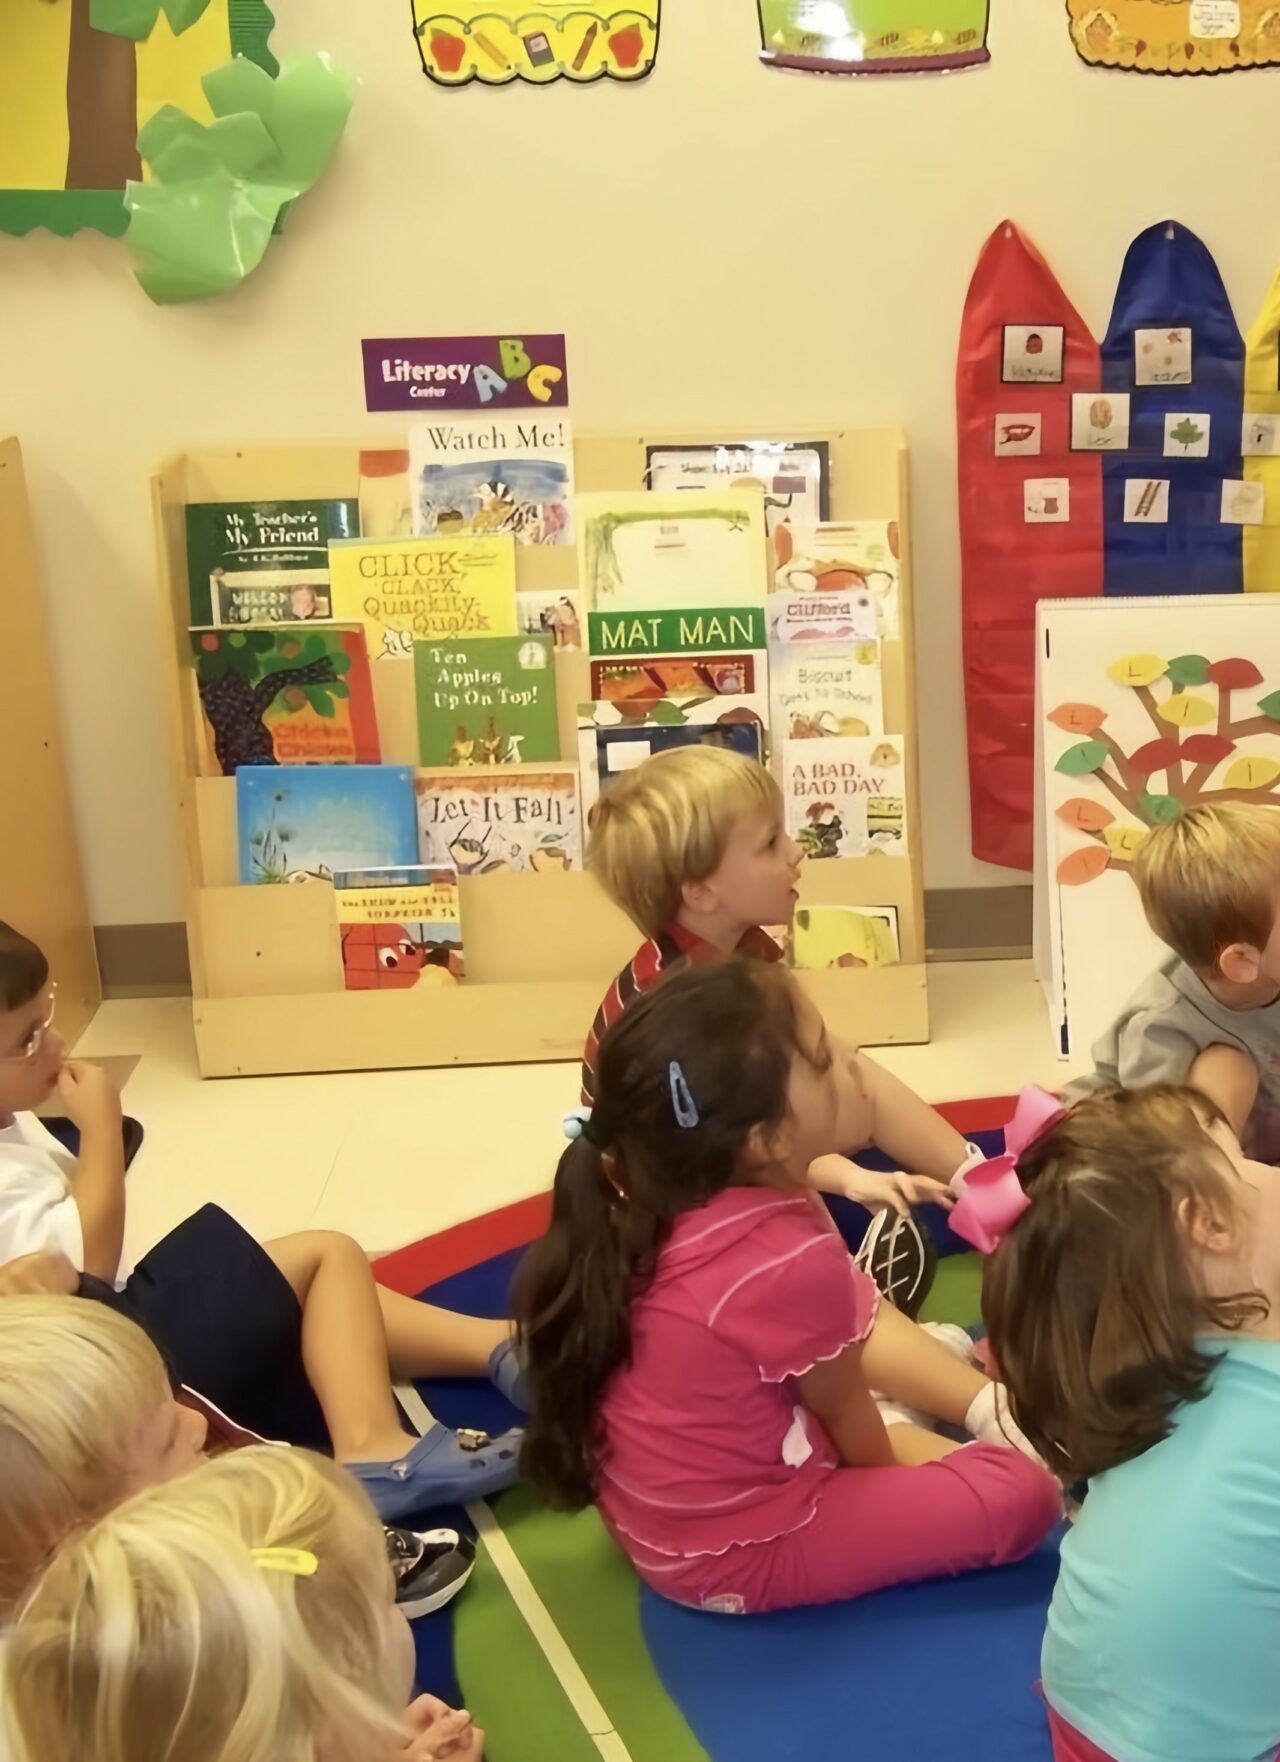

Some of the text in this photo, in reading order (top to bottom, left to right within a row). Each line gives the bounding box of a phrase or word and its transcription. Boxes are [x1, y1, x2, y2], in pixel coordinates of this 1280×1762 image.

[381, 358, 471, 384] Literacy
[409, 385, 447, 398] Center
[426, 423, 565, 451] Watch Me!
[259, 527, 319, 544] Friend
[359, 551, 469, 580] CLICK,
[601, 614, 754, 650] MAT MAN
[429, 647, 467, 665] Ten
[437, 668, 503, 689] Apples
[463, 690, 493, 707] On
[497, 685, 538, 707] Top!
[792, 764, 806, 780] A
[793, 777, 885, 797] BAD DAY
[430, 795, 562, 825] Let It Fall
